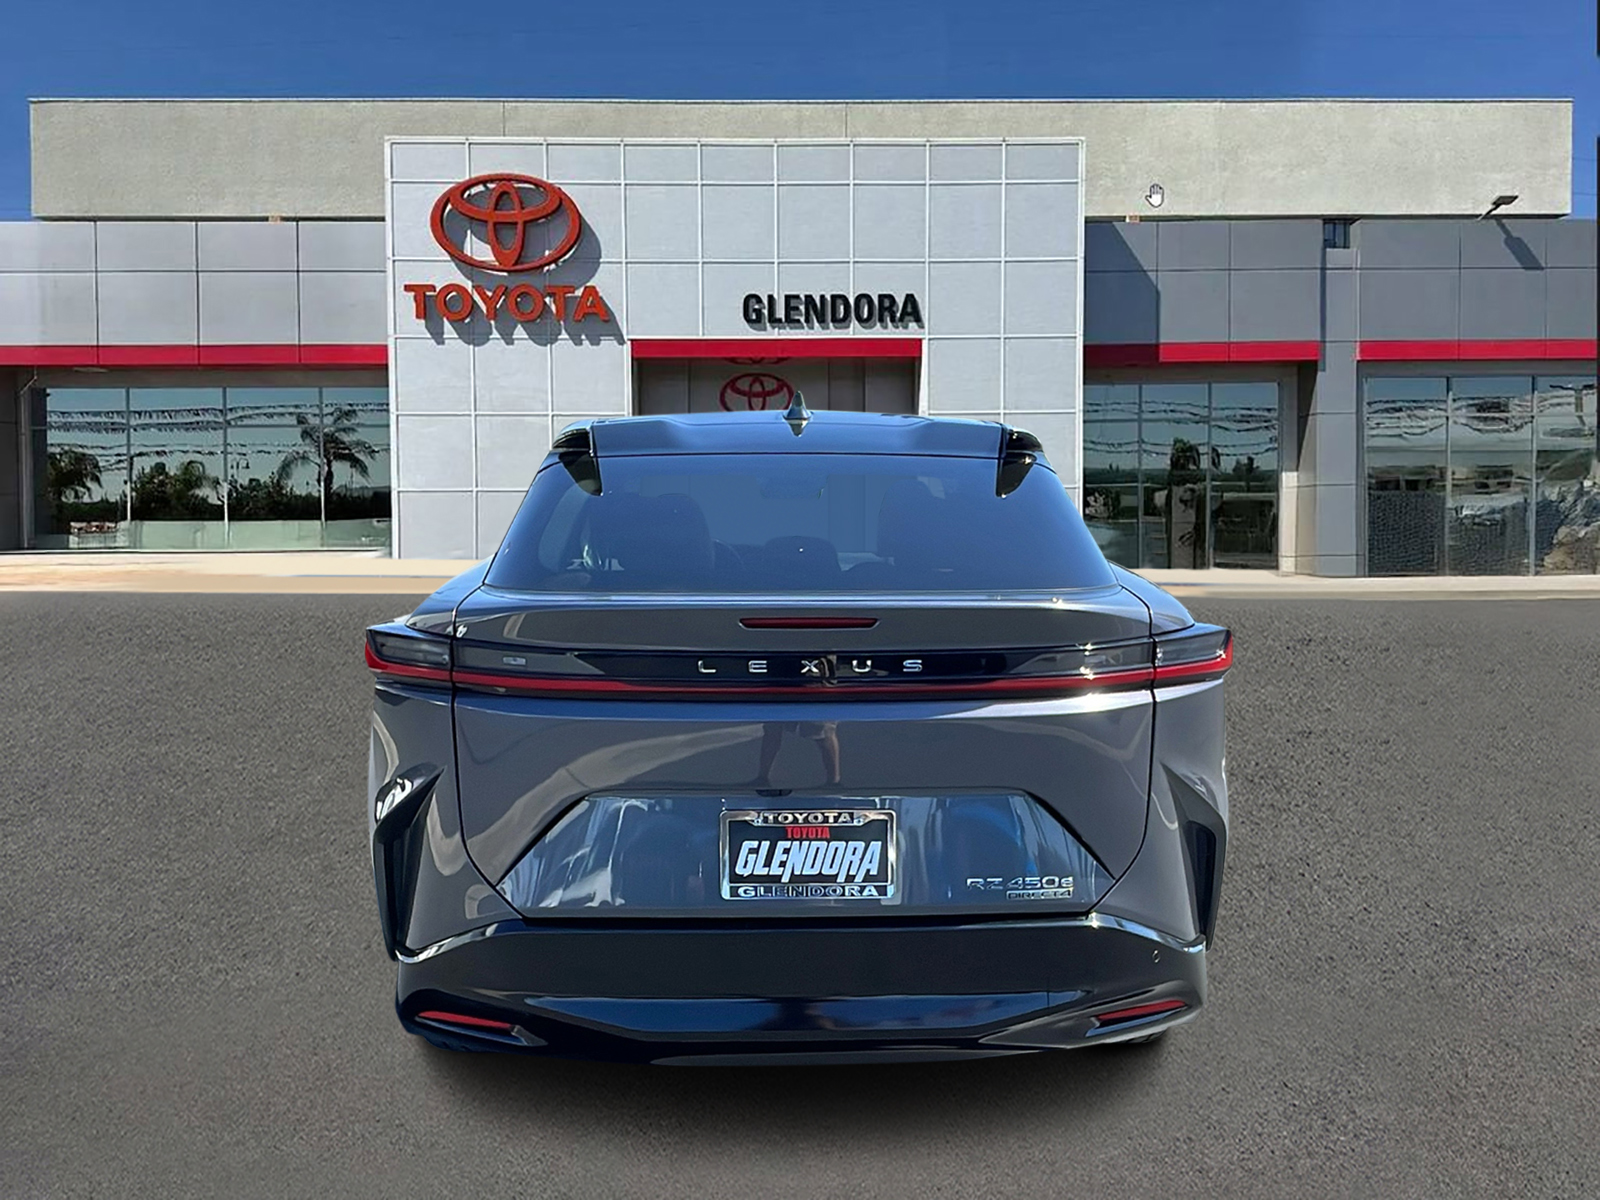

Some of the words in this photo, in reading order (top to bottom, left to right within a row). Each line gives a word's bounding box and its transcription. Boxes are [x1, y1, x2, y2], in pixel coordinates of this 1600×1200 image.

[403, 283, 611, 323] TOYOTA
[743, 293, 922, 325] GLENDORA
[697, 659, 923, 673] LEXUS
[763, 812, 852, 824] TOYOTA
[786, 826, 830, 839] TOYOTA
[735, 840, 882, 883] GLENDORA
[966, 877, 1004, 890] RZ
[1006, 875, 1074, 889] 450e
[737, 885, 879, 897] GLENDORA
[1007, 888, 1073, 899] DIRECT4
